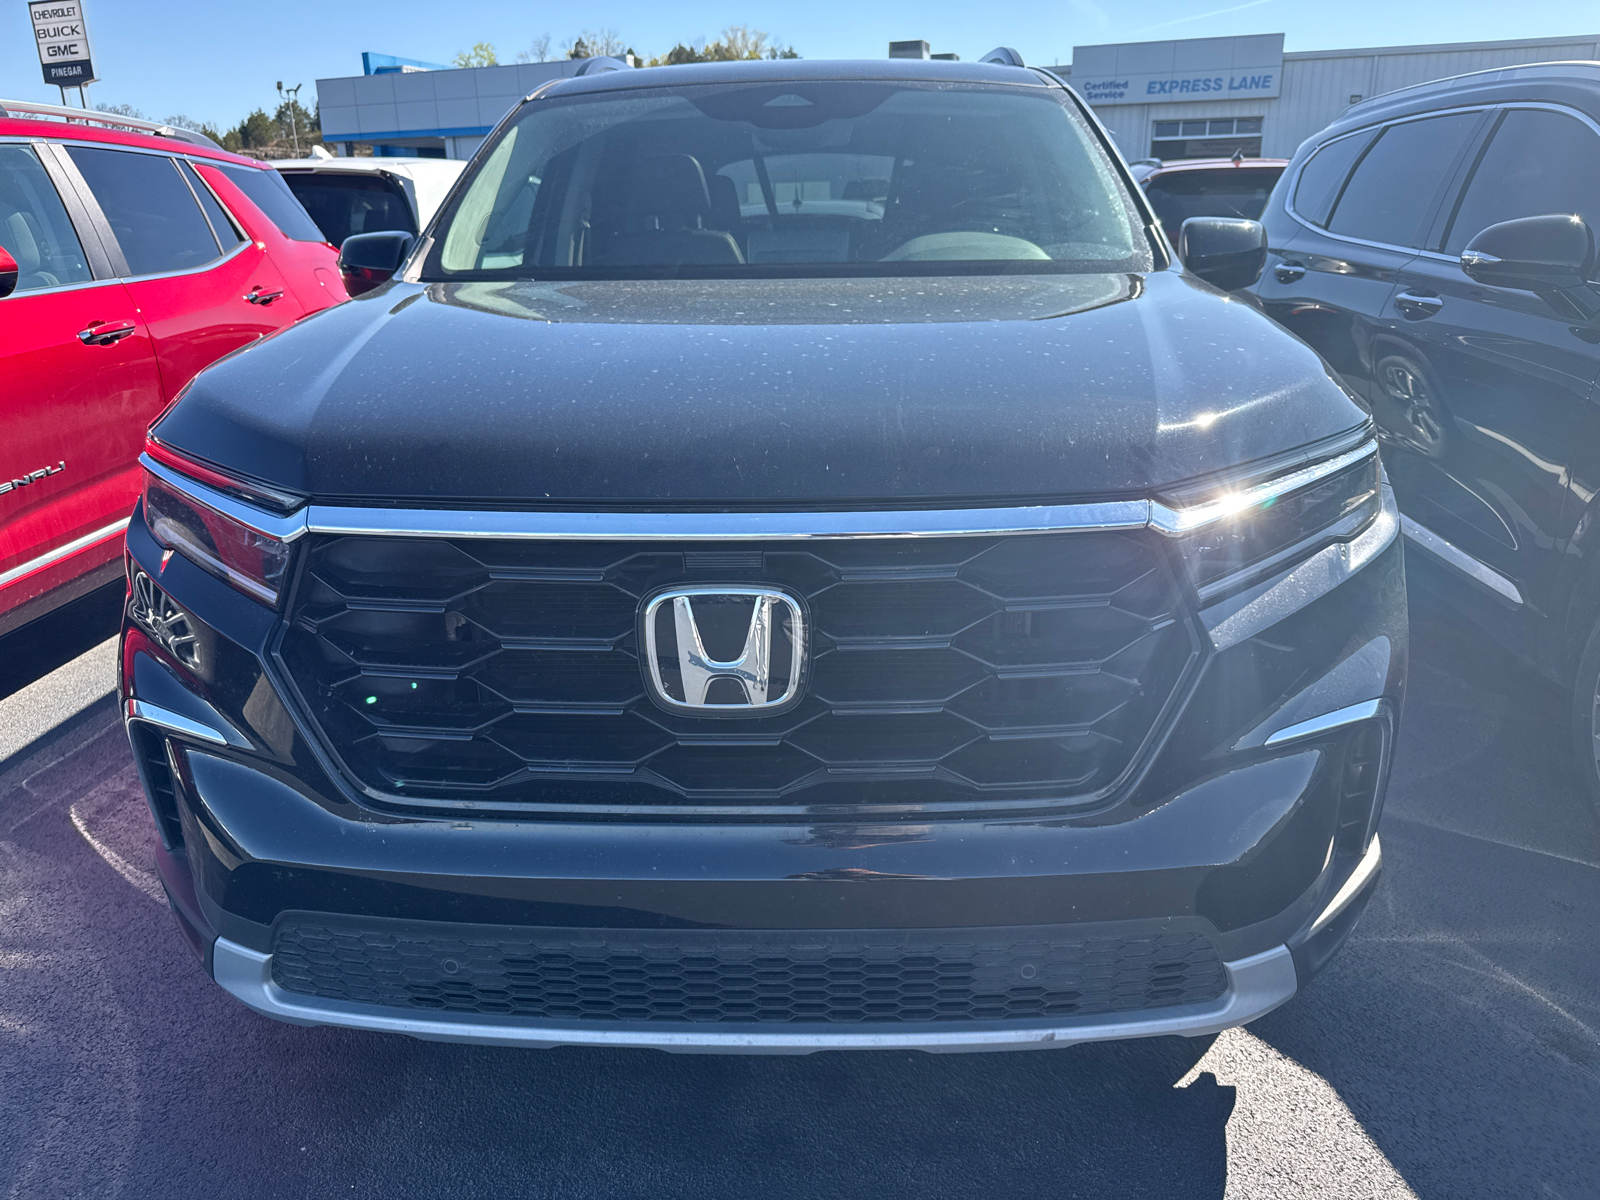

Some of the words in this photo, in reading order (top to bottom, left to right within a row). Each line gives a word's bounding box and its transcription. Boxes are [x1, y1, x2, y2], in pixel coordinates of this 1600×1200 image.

[34, 7, 76, 20] CHEVROLET
[37, 25, 81, 39] BUICK
[47, 44, 79, 57] GMC
[51, 66, 83, 77] PINEGAR
[1084, 80, 1129, 91] Certified
[1146, 77, 1223, 95] EXPRESS
[1227, 75, 1273, 91] LANE
[1086, 91, 1125, 100] Service
